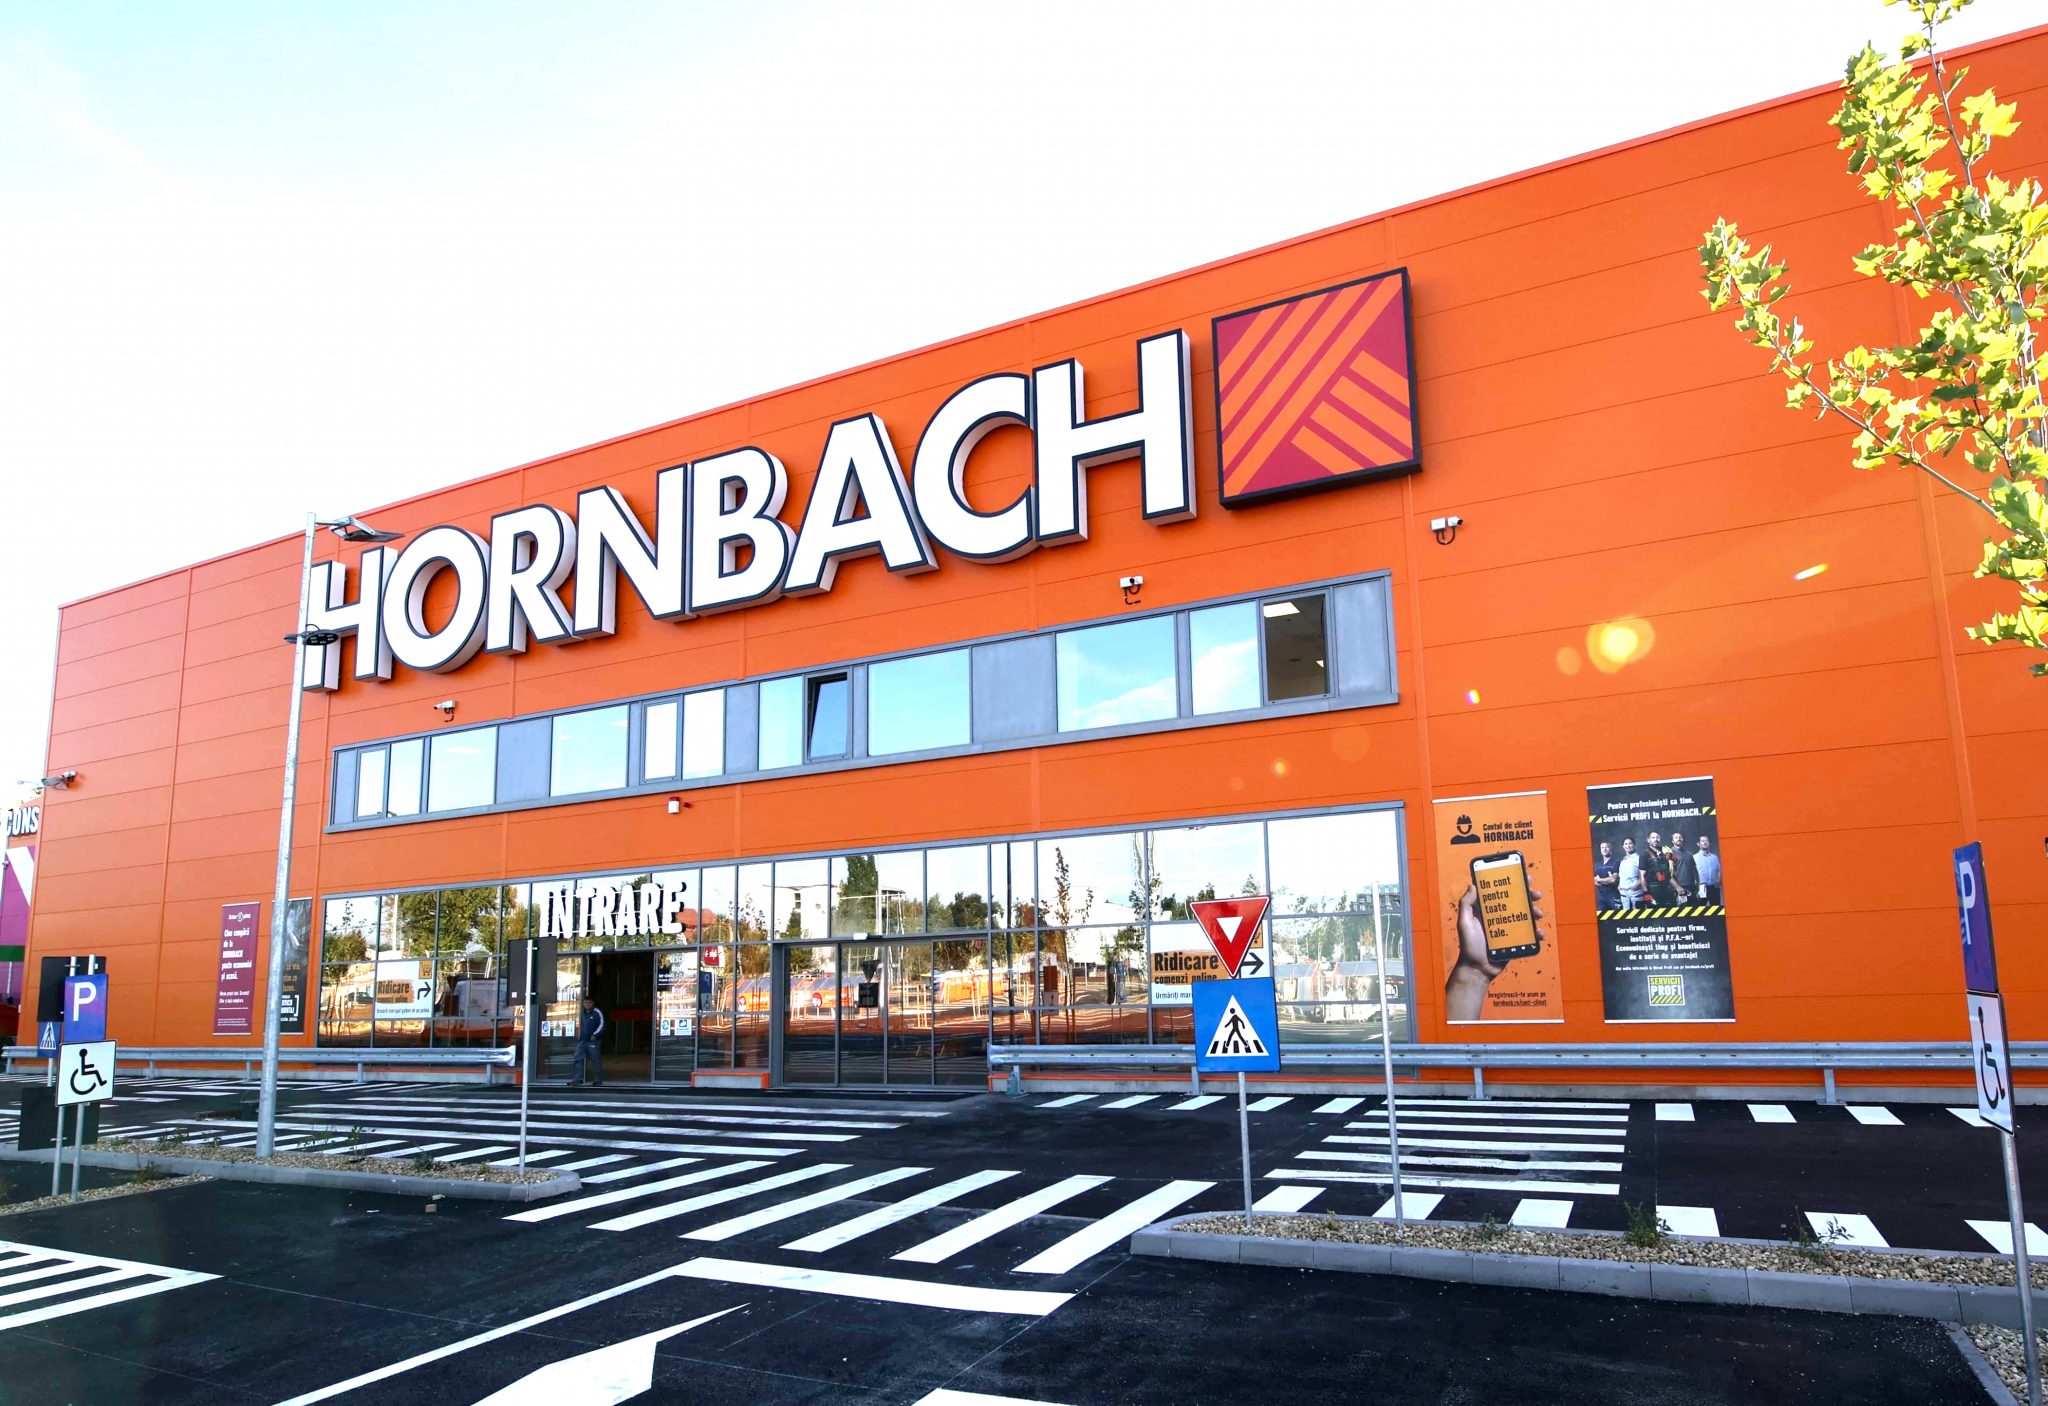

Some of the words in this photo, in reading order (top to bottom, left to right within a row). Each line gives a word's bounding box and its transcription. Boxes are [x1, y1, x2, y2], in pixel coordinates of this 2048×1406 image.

[303, 329, 1196, 693] HORNBACH
[1603, 814, 1628, 823] Servicii
[1630, 811, 1651, 821] PROFI
[1653, 811, 1660, 819] la
[1662, 808, 1702, 819] HORNBACH.
[1504, 821, 1512, 829] de
[1514, 820, 1533, 828] client
[1484, 829, 1534, 843] HORNBACH
[1480, 880, 1491, 889] Un
[1493, 876, 1511, 887] cont
[1482, 890, 1509, 903] pentru
[1959, 861, 1975, 945] P
[538, 882, 687, 938] INTRARE
[1485, 903, 1507, 914] toate
[1487, 912, 1528, 928] proiectele
[1489, 928, 1508, 938] tale.
[1154, 952, 1218, 971] Ridicare
[1154, 972, 1188, 984] comenzi
[1650, 977, 1681, 985] SERVICII
[377, 980, 410, 994] Ridicare
[1650, 985, 1681, 996] PROFI
[72, 981, 97, 1022] P
